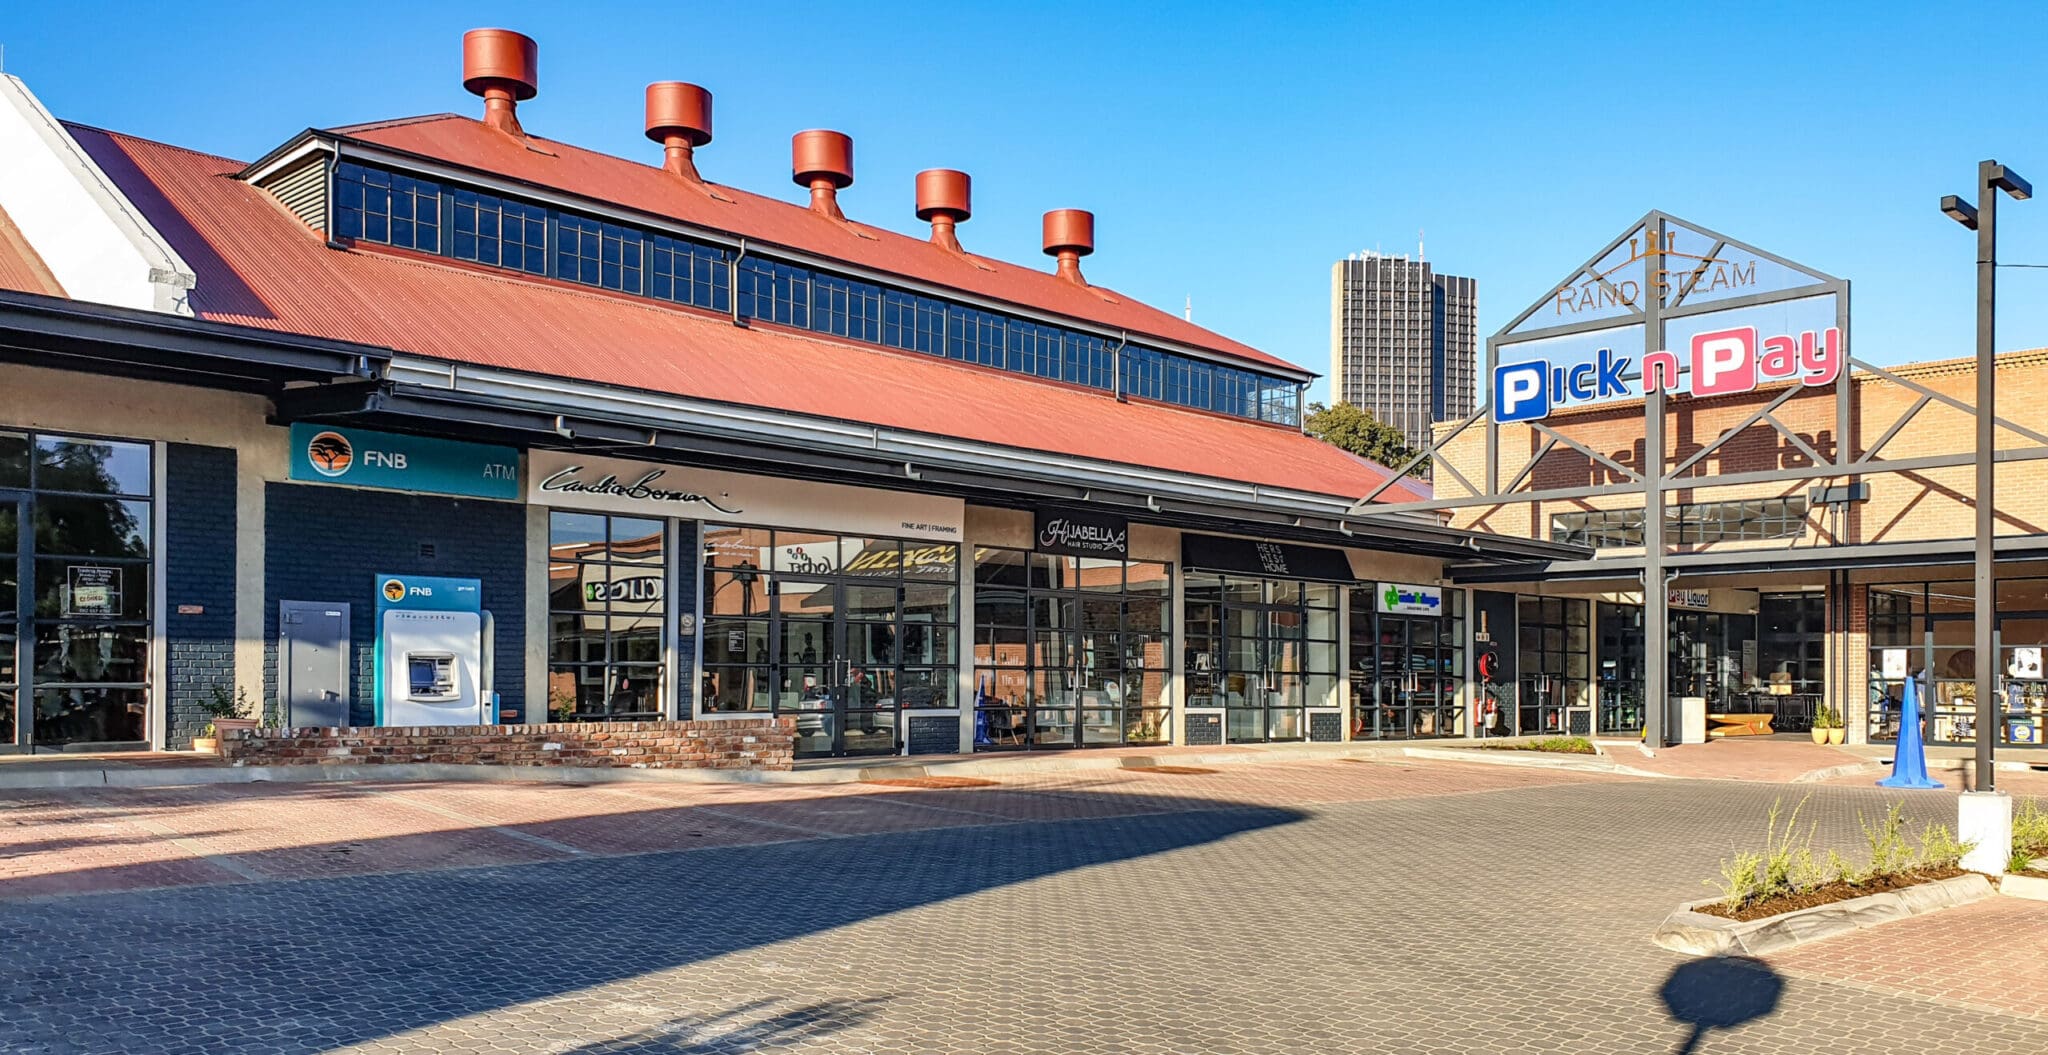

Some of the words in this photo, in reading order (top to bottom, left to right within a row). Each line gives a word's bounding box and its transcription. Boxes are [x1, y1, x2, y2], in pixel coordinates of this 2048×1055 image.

[1556, 280, 1640, 315] RAND
[1650, 260, 1757, 301] STEAM
[1494, 346, 1633, 424] Pick
[1641, 350, 1681, 394] n
[1690, 324, 1845, 398] Pay
[363, 450, 408, 469] FNB
[483, 463, 516, 480] ATM
[901, 522, 915, 530] FINE
[915, 523, 928, 531] ART
[931, 525, 957, 534] FRAMING
[1082, 542, 1103, 550] STUDIO
[1256, 543, 1282, 554] HERS
[1263, 562, 1289, 574] HOME
[410, 587, 433, 597] FNB
